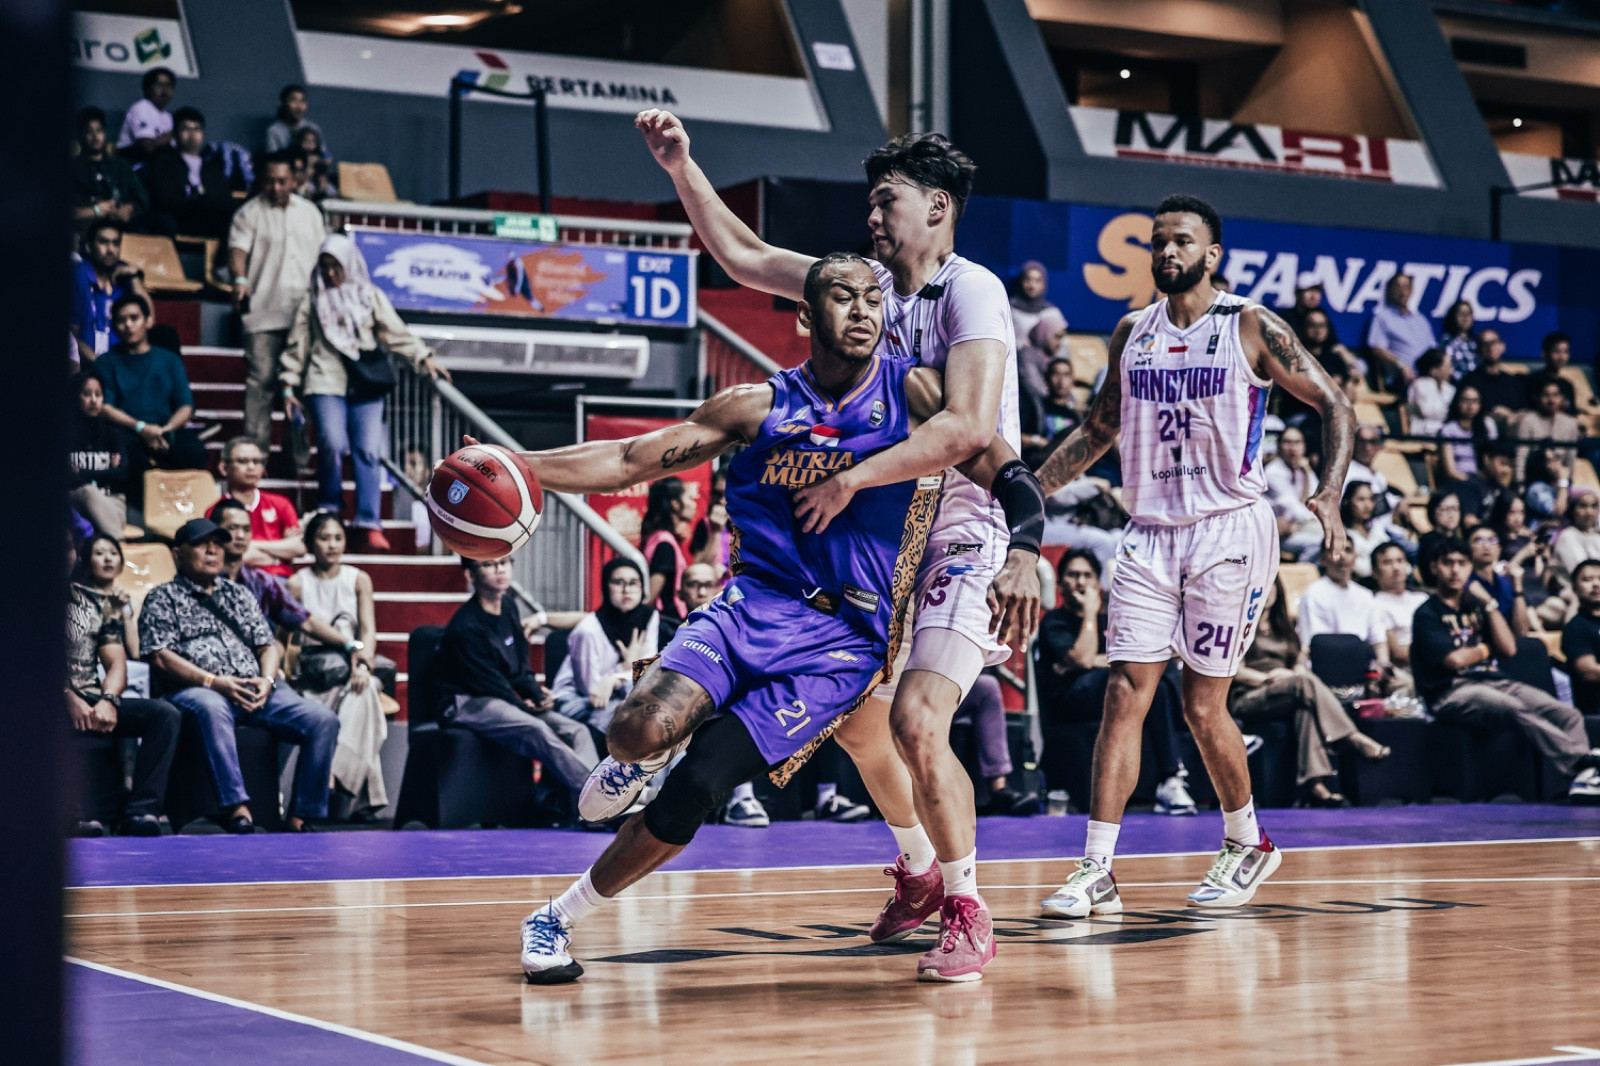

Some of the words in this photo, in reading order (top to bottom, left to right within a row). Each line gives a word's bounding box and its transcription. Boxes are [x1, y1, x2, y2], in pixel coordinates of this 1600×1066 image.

[525, 74, 678, 105] PERTAMINA
[638, 255, 673, 274] EXIT
[630, 275, 681, 318] 1D
[1222, 249, 1542, 324] FANATICS
[1158, 408, 1191, 442] 24
[760, 464, 839, 485] MUD
[1193, 621, 1234, 659] 24
[774, 699, 812, 738] 21
